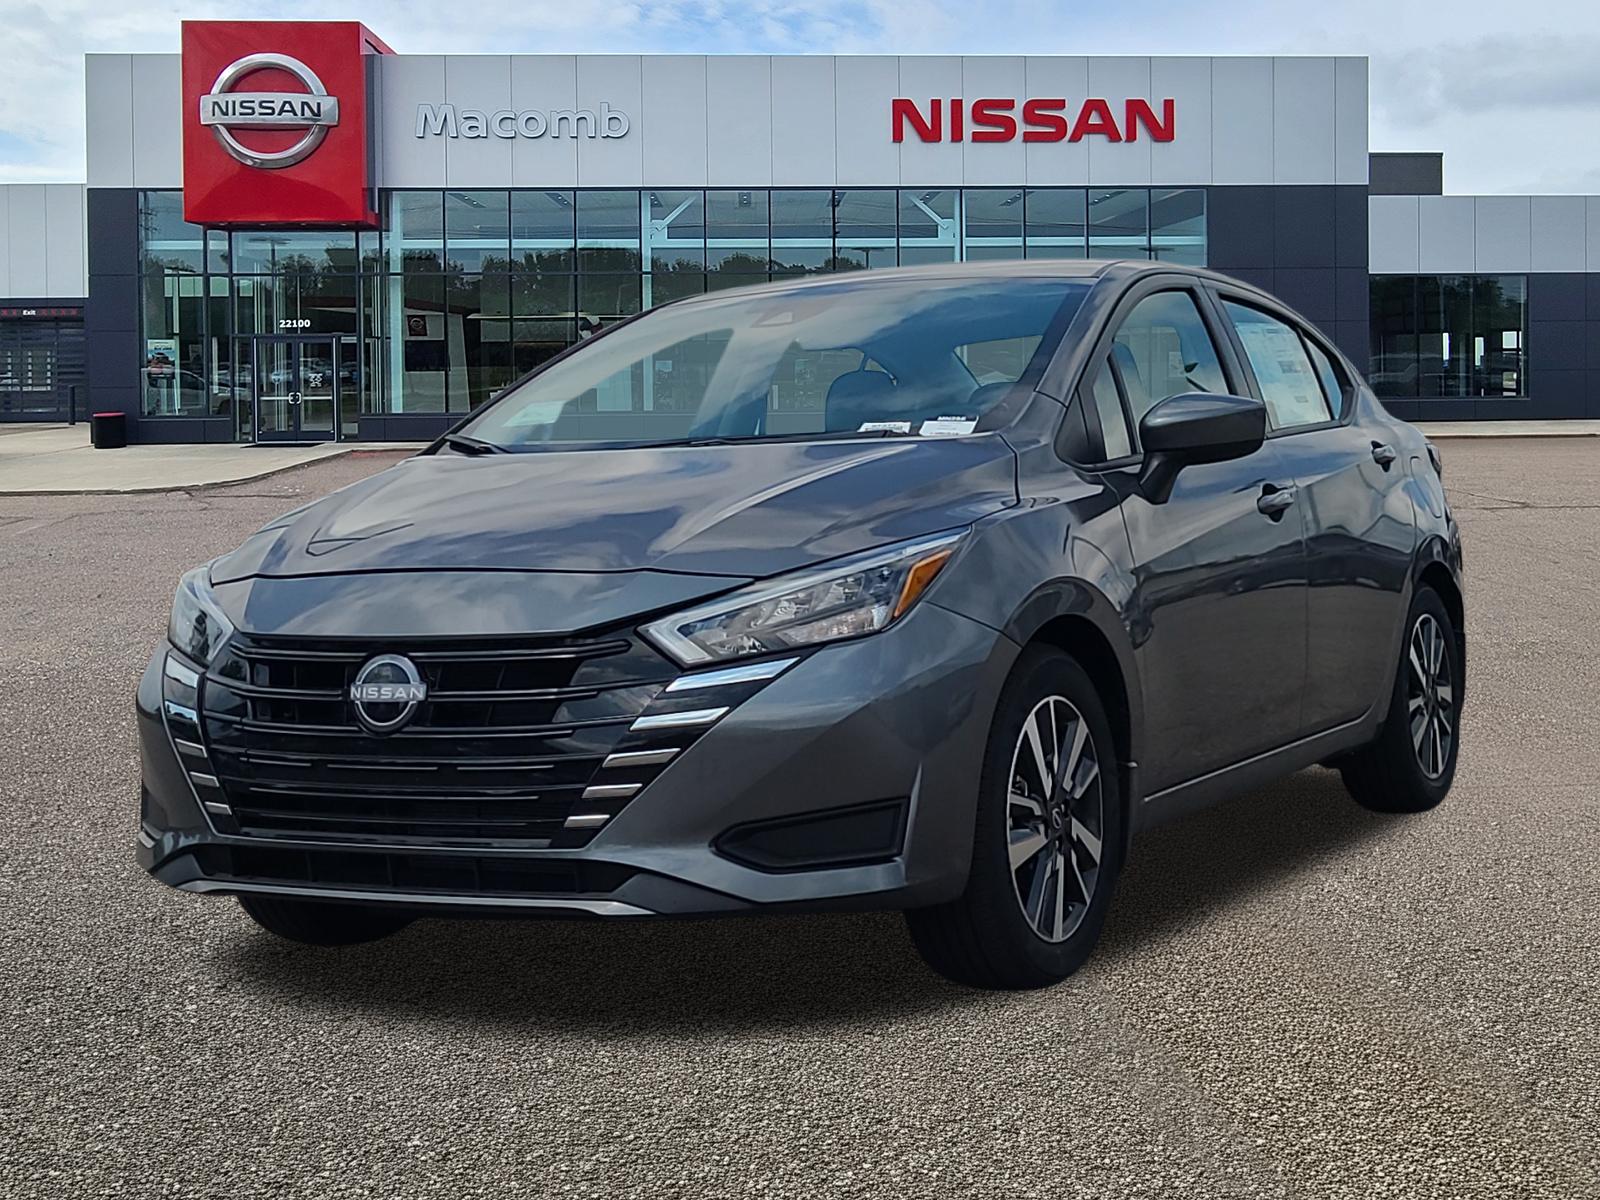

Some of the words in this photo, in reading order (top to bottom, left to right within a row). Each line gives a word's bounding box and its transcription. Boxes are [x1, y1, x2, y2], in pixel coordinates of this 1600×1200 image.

[211, 99, 322, 118] NISSAN
[415, 101, 630, 139] Macomb
[891, 98, 1176, 143] NISSAN
[279, 319, 311, 328] 22100
[350, 687, 424, 699] NISSAN
